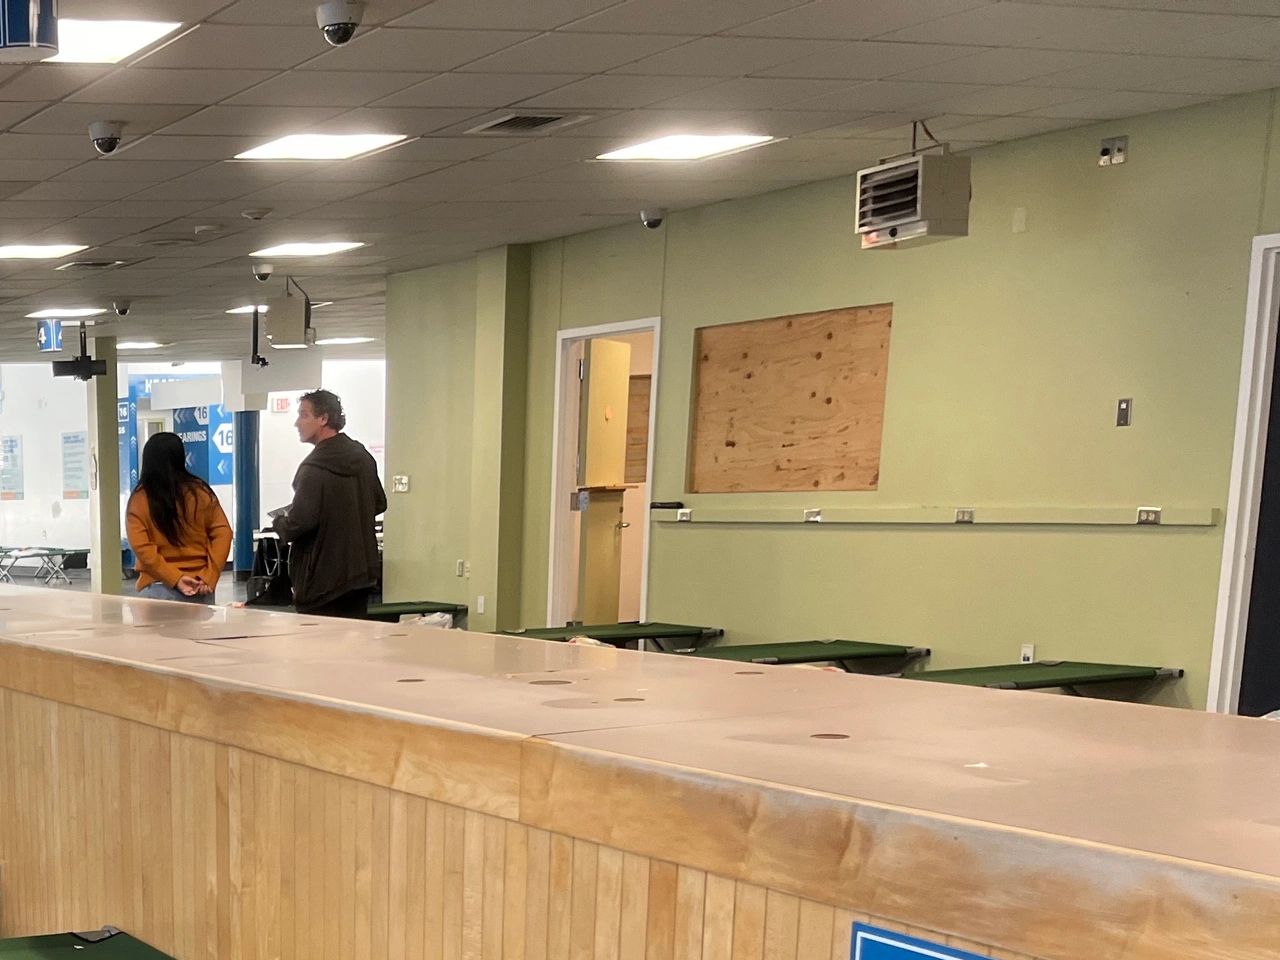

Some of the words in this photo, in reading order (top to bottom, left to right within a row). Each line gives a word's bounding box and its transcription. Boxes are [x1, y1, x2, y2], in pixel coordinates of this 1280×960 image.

[197, 406, 208, 419] 16
[177, 430, 207, 443] EARINGS
[218, 429, 233, 447] 16
